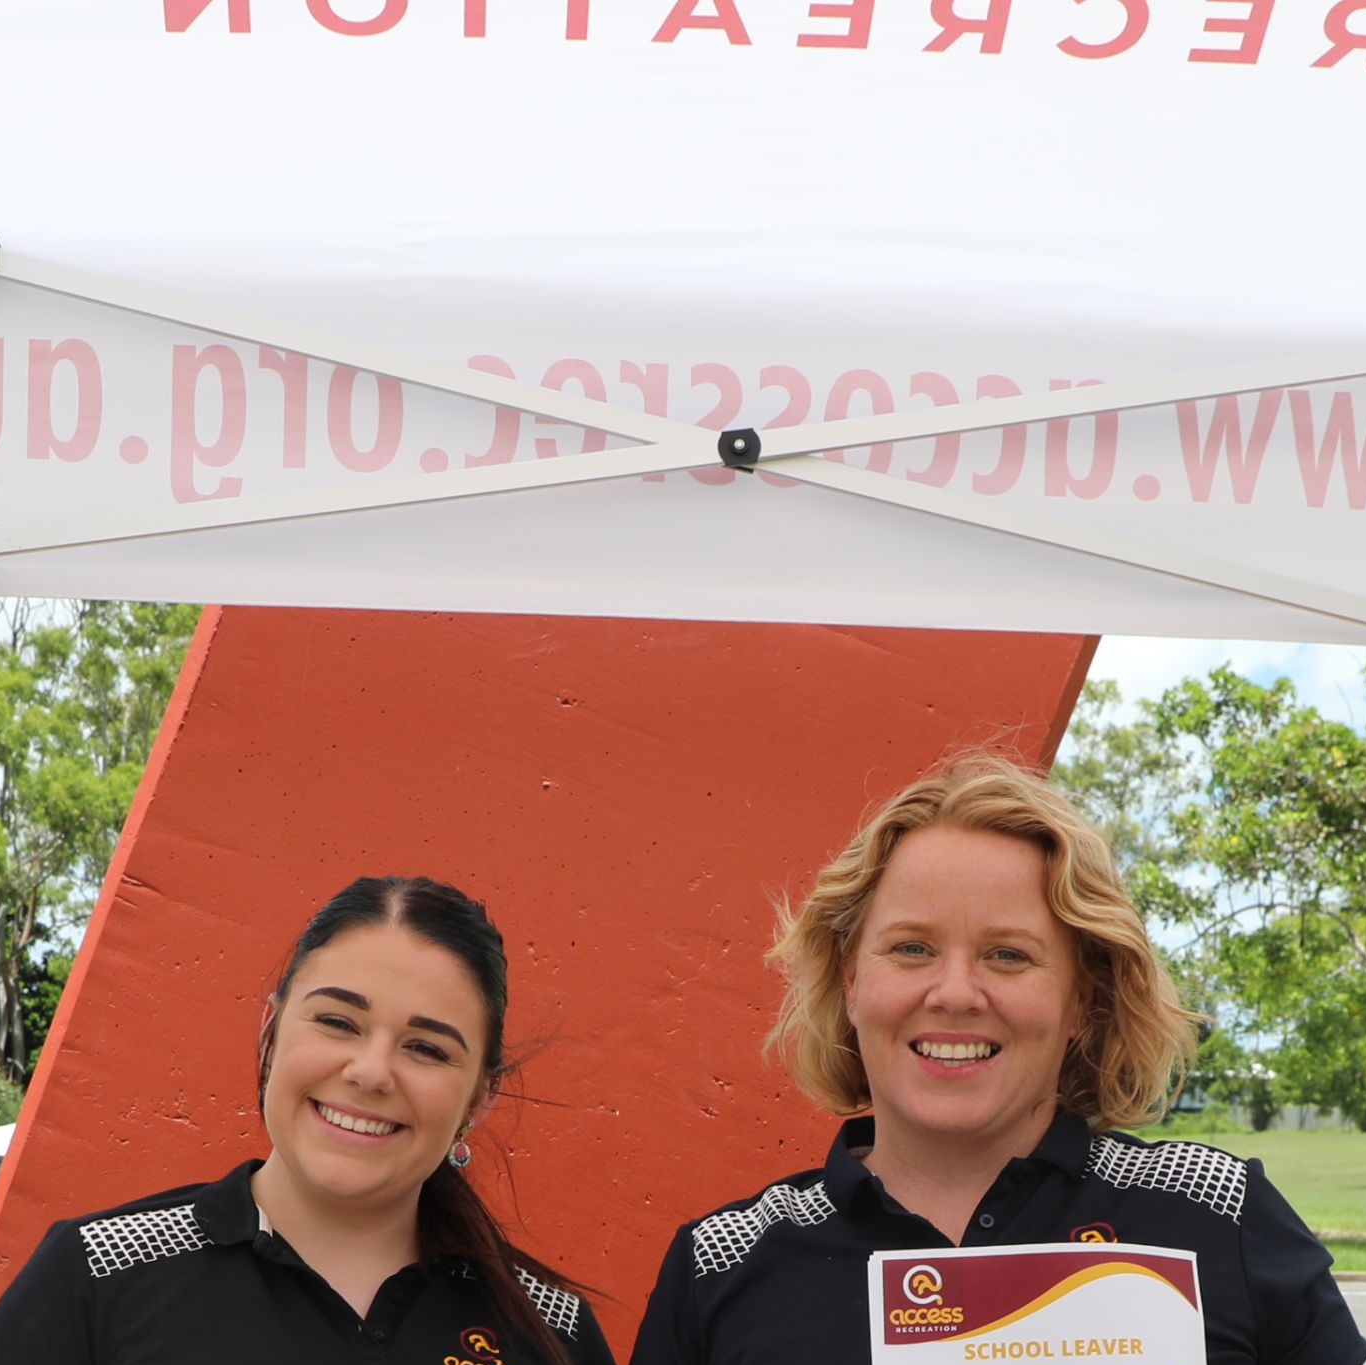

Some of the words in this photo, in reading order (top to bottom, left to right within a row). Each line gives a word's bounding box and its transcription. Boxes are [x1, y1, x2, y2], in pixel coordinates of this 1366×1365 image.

[889, 1307, 965, 1325] access
[895, 1325, 957, 1334] RECREATION
[964, 1341, 1055, 1361] SCHOOL
[1061, 1338, 1144, 1357] LEAVER
